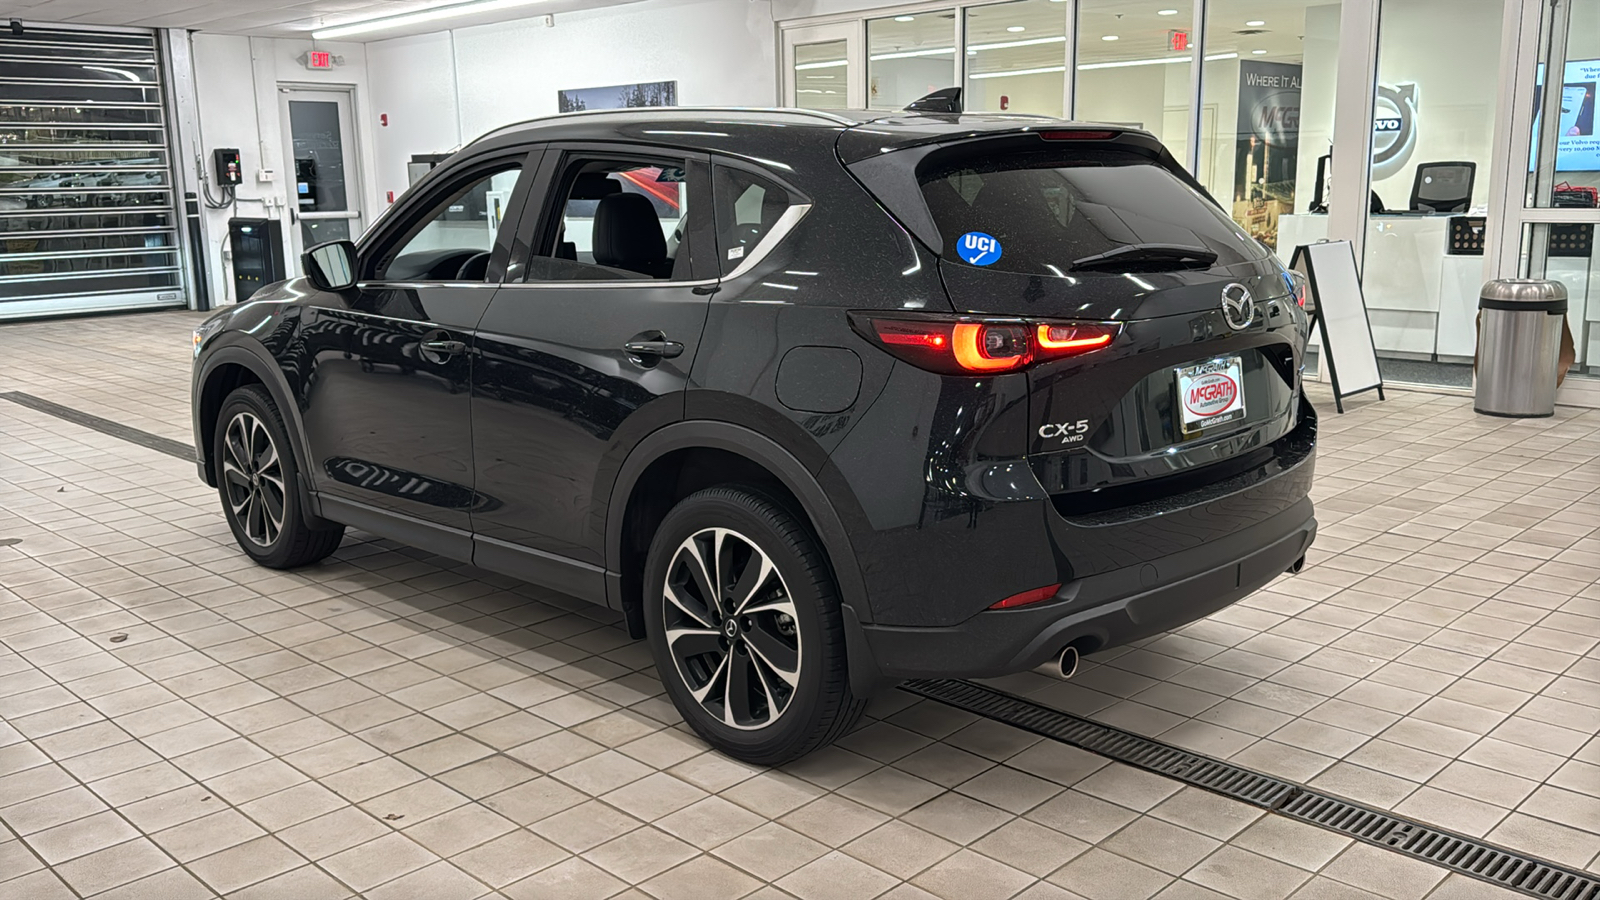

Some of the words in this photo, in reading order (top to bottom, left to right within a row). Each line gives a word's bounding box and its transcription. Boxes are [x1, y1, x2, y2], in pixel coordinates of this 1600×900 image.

[1174, 32, 1187, 50] EXIT
[311, 51, 330, 67] EXIT
[1246, 73, 1279, 88] WHERE
[965, 234, 996, 253] UCI
[1190, 381, 1232, 405] McGRATH
[1200, 399, 1219, 408] Automotive
[1038, 419, 1089, 439] CX-5
[1201, 414, 1233, 428] GoMcGrath.com
[1061, 434, 1084, 444] AWD
